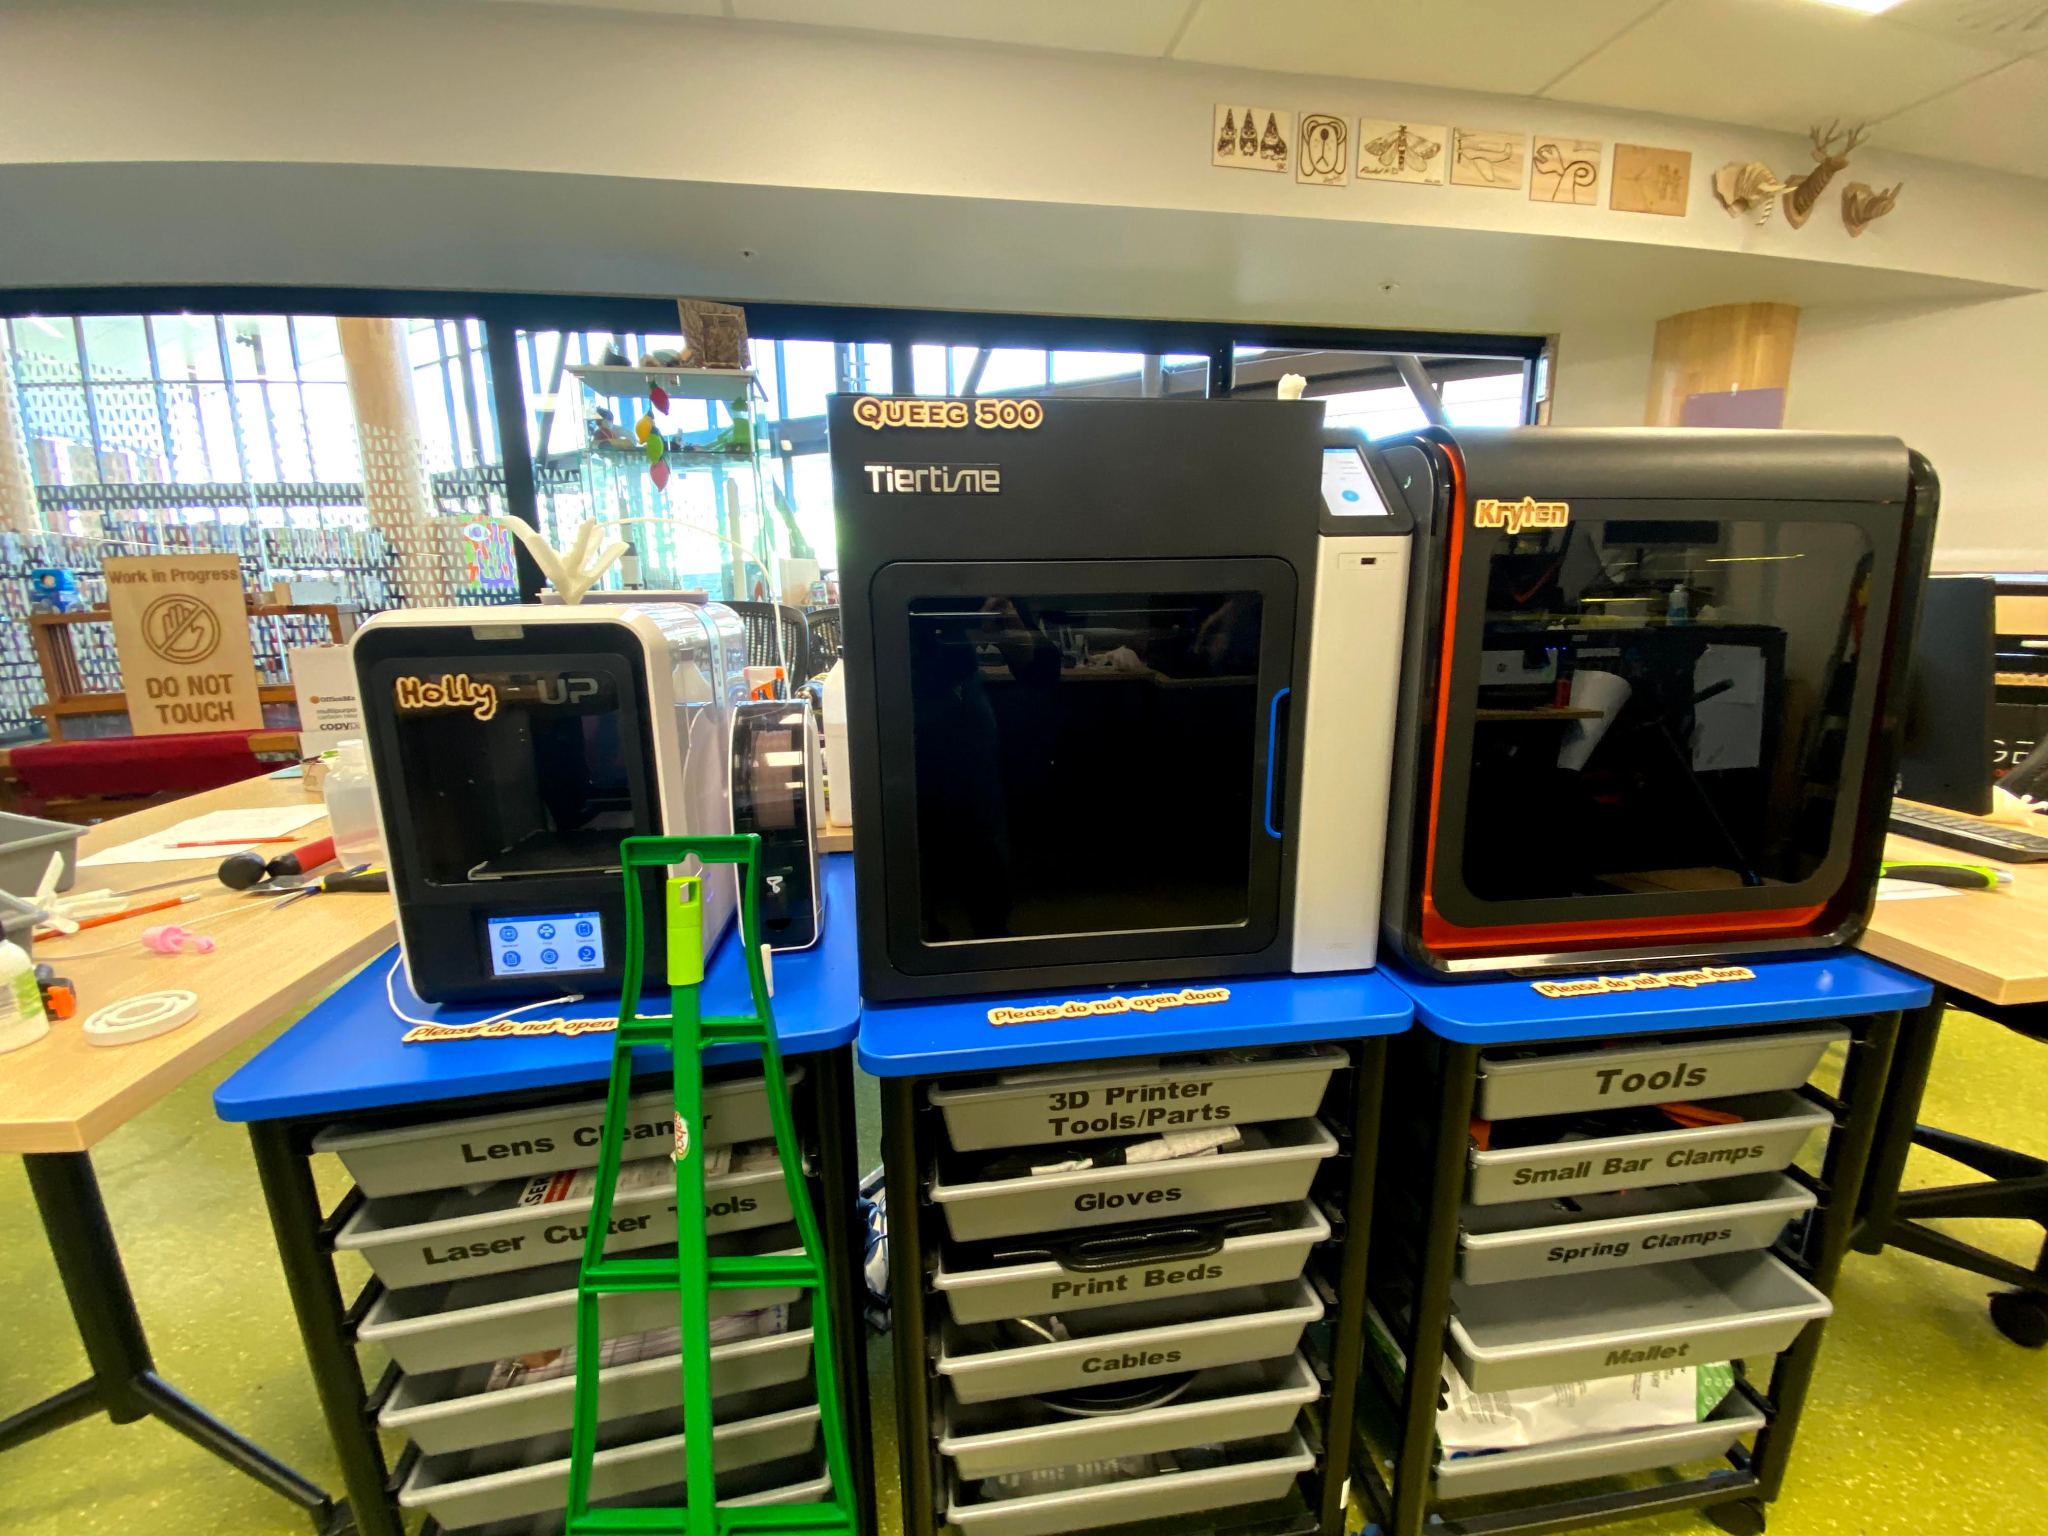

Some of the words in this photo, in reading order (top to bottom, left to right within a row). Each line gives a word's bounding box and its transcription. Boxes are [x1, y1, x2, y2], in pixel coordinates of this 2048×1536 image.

[856, 399, 966, 426] QUEEG
[979, 401, 1041, 426] 500
[864, 465, 1000, 493] Tiertime
[1477, 499, 1566, 531] Kryten
[110, 570, 147, 584] Work
[152, 569, 166, 581] in
[171, 568, 238, 584] Progress
[146, 676, 179, 699] DO
[187, 674, 233, 696] NOT
[398, 674, 495, 719] Holly
[537, 677, 598, 705] UP
[155, 701, 235, 724] TOUCH
[1540, 982, 1602, 995] Please
[1606, 978, 1627, 989] do
[1633, 974, 1658, 986] not
[1666, 971, 1708, 985] open
[1712, 967, 1747, 979] door
[994, 1006, 1063, 1022] Please
[1065, 1003, 1087, 1014] do
[1095, 999, 1125, 1012] not
[1133, 994, 1178, 1009] open
[1184, 988, 1226, 1002] door
[410, 1025, 481, 1039] Please
[487, 1021, 514, 1033] do
[521, 1019, 559, 1032] not
[563, 1018, 616, 1032] open
[1596, 1063, 1707, 1095] Tools
[1048, 1090, 1090, 1112] 3D
[1105, 1081, 1213, 1106] Printer
[1048, 1103, 1231, 1137] Tools/Parts
[461, 1137, 555, 1163] Lens
[573, 1114, 712, 1147] Canr
[1513, 1161, 1592, 1186] Small
[1602, 1157, 1653, 1176] Bar
[1666, 1145, 1765, 1168] Clamps
[1074, 1186, 1182, 1212] Gloves
[422, 1235, 526, 1266] Laser
[543, 1214, 652, 1245] Cuter
[668, 1196, 758, 1218] ols
[1547, 1240, 1630, 1263] Spring
[1642, 1228, 1732, 1250] Clamps
[1051, 1274, 1129, 1300] Print
[1144, 1264, 1223, 1288] Beds
[1081, 1350, 1182, 1374] Cables
[1604, 1343, 1690, 1367] Mallet
